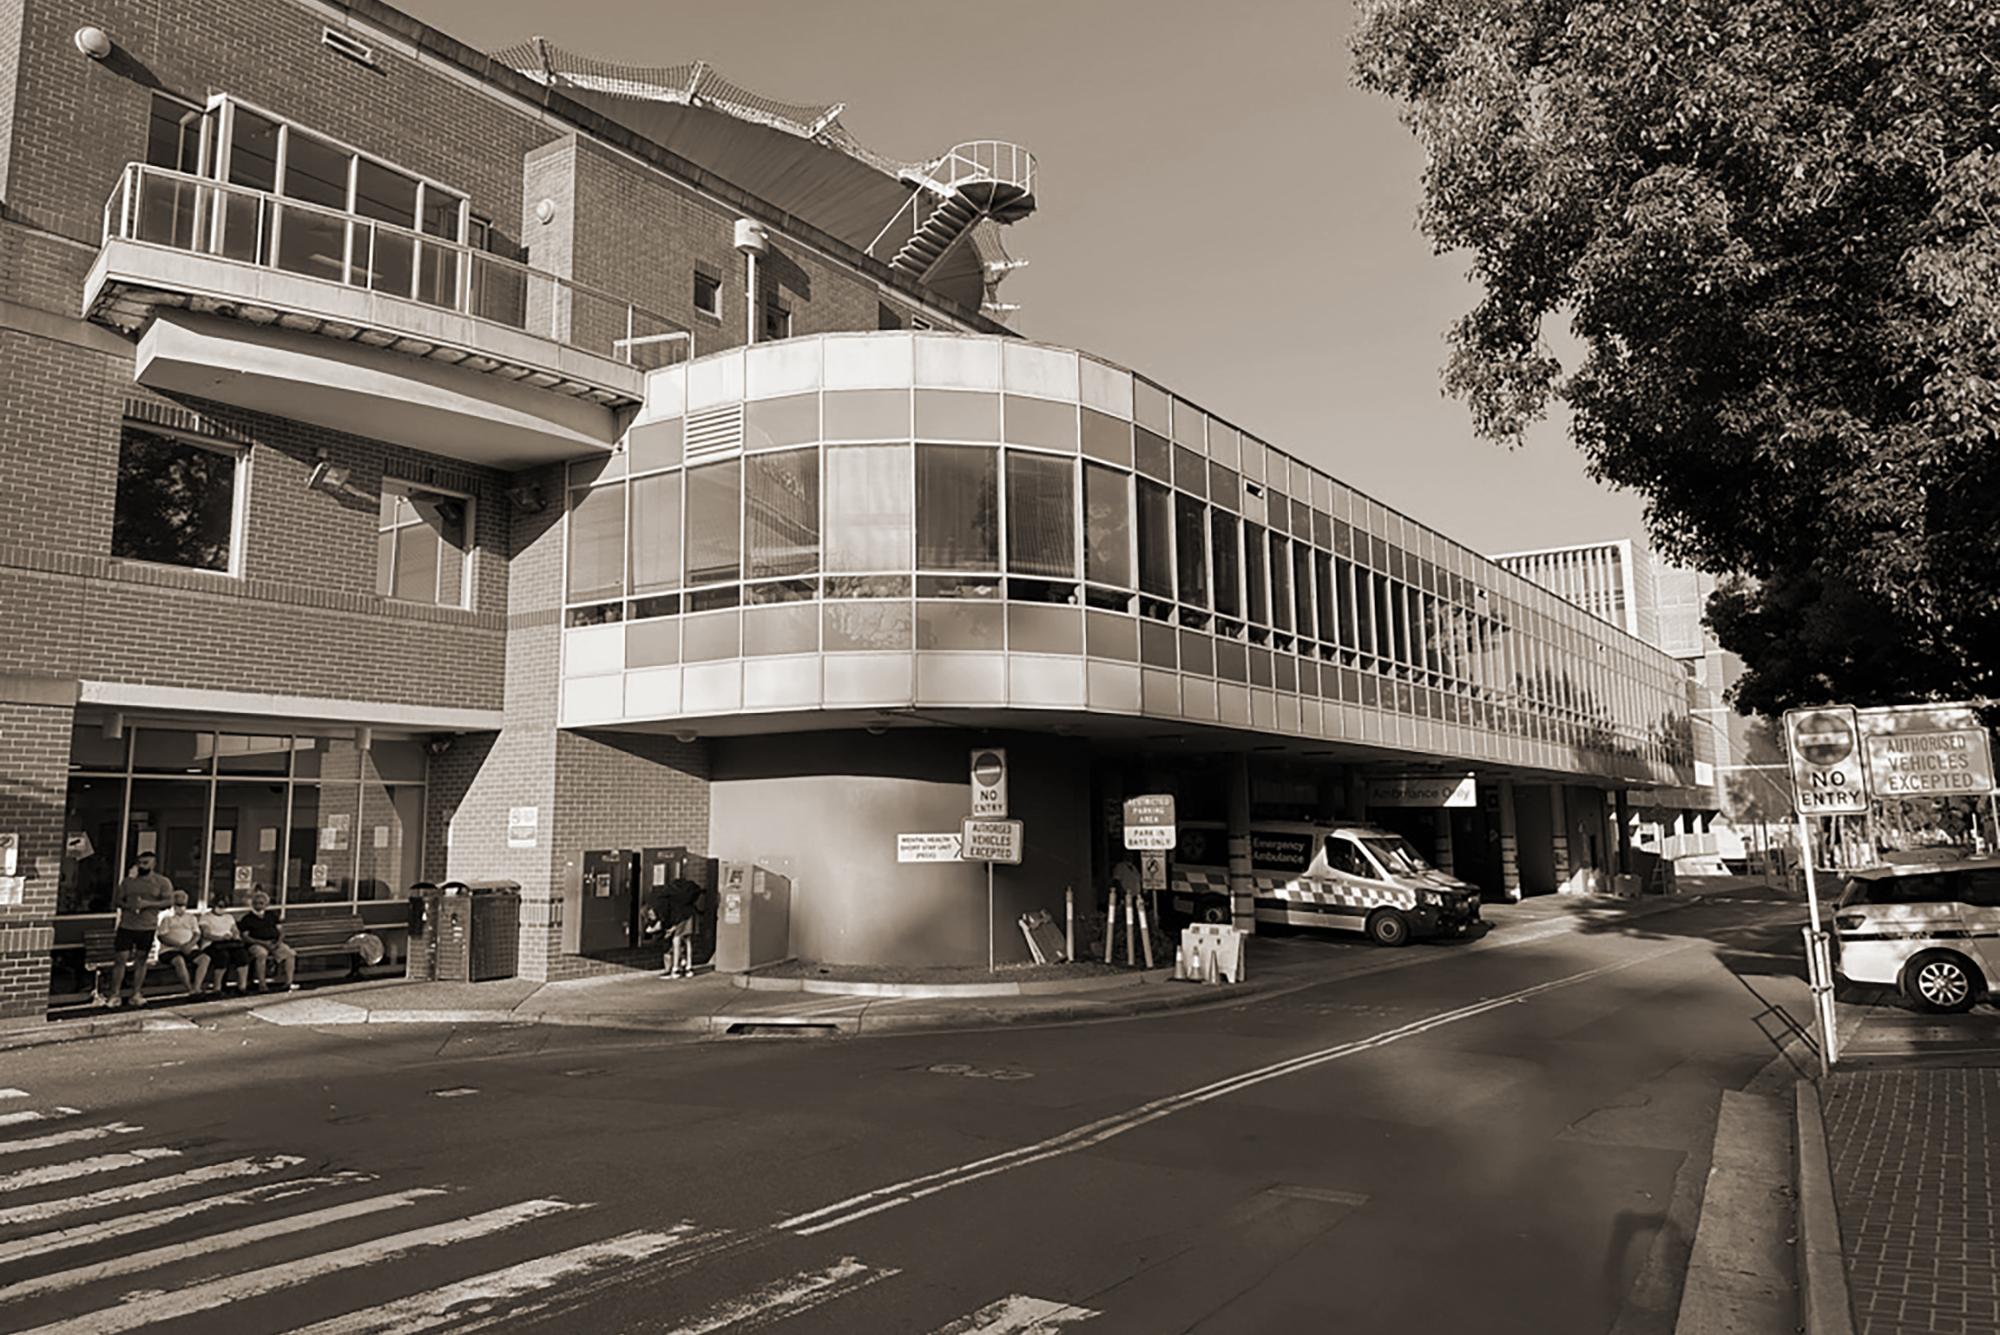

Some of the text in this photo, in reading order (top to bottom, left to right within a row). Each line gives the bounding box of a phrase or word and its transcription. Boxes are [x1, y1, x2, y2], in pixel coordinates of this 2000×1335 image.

[1886, 735, 1966, 753] AUTHORISED
[1888, 753, 1969, 772] VEHICLES
[1812, 771, 1845, 787] NO
[1888, 772, 1973, 791] EXCEPTED
[980, 789, 997, 801] NO
[1442, 787, 1470, 801] Oly
[1802, 791, 1860, 806] ENTRY
[974, 803, 1002, 813] ENTRY
[1132, 807, 1165, 815] PARKING
[1139, 816, 1159, 824] AREA
[972, 823, 1012, 834] AUTHORISED
[1134, 829, 1154, 837] PARK
[972, 835, 1012, 846] VEHICLES
[1150, 839, 1170, 847] ONLY
[1253, 837, 1306, 852] Emergency
[970, 847, 1012, 858] EXCEPTED
[1253, 850, 1306, 864] Ambulance
